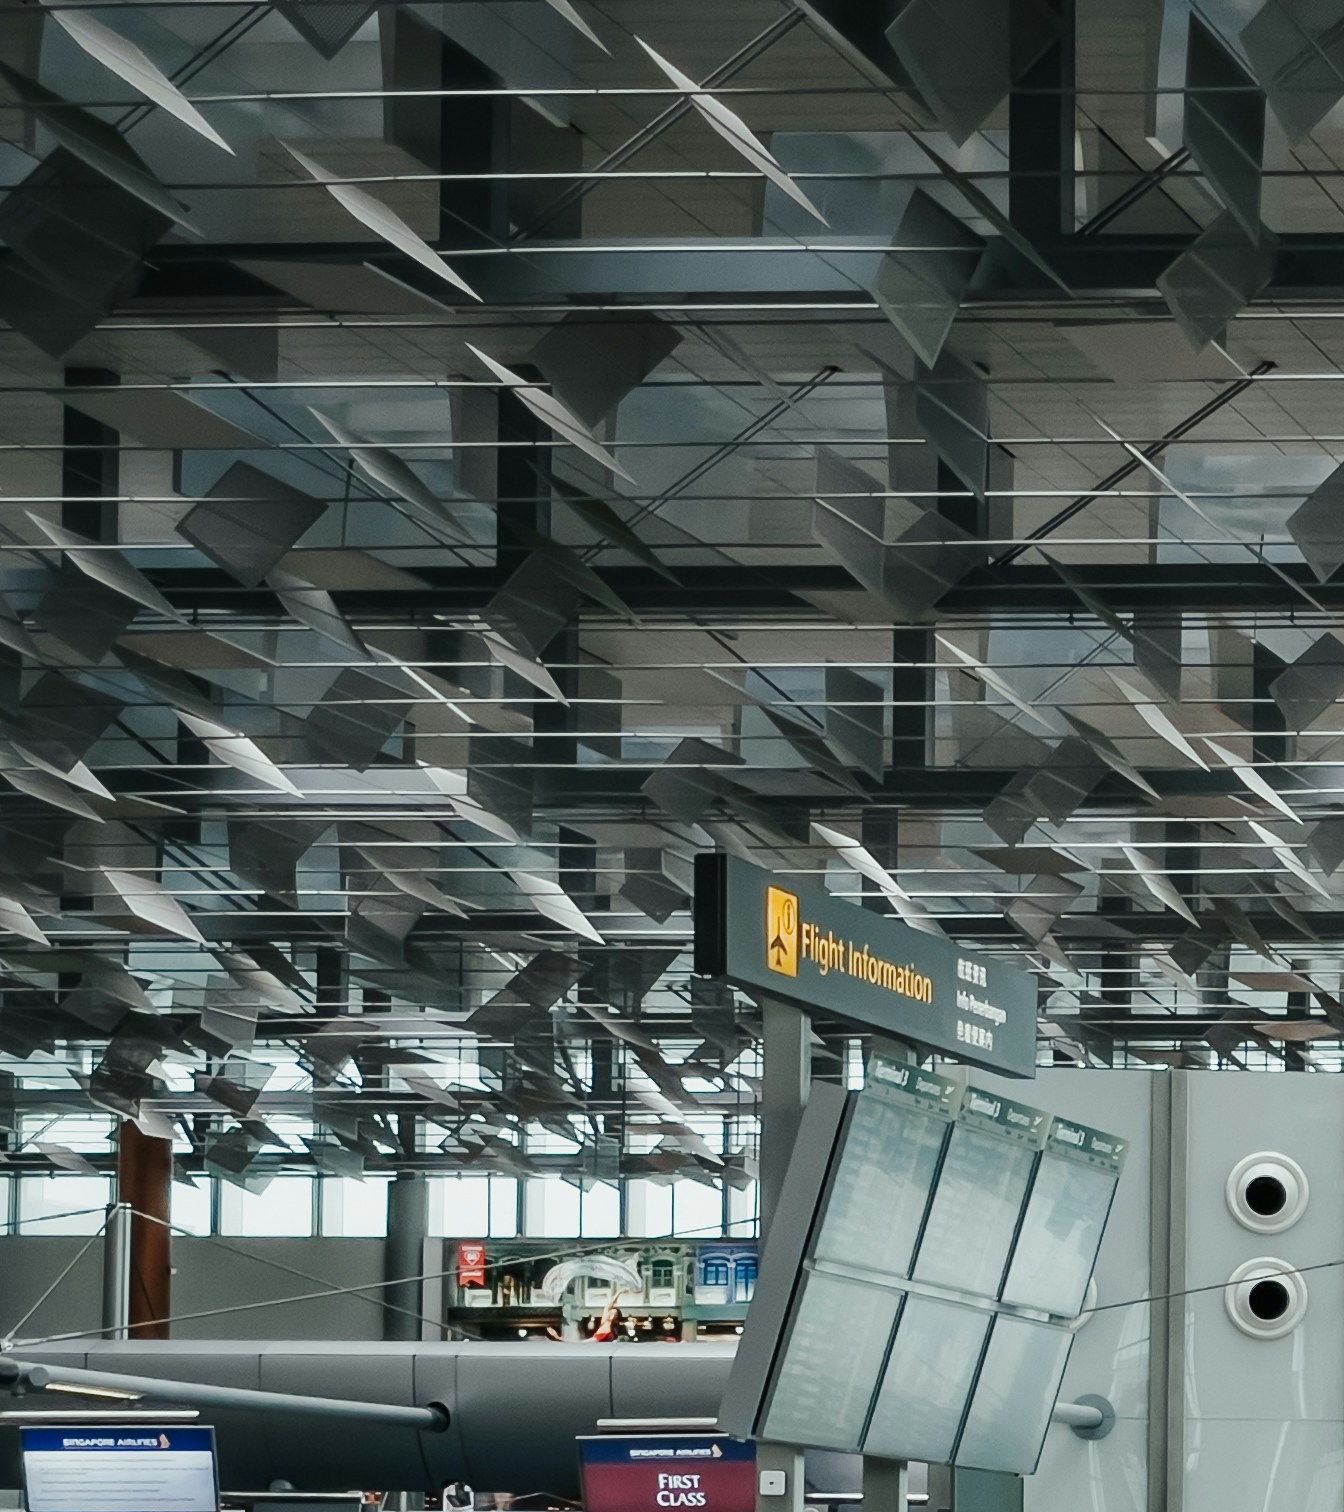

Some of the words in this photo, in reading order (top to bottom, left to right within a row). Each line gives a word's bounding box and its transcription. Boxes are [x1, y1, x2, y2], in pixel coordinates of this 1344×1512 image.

[802, 923, 845, 976] Flight
[849, 941, 933, 1004] Information
[658, 1473, 701, 1489] FIRST
[656, 1490, 706, 1507] CLASS
